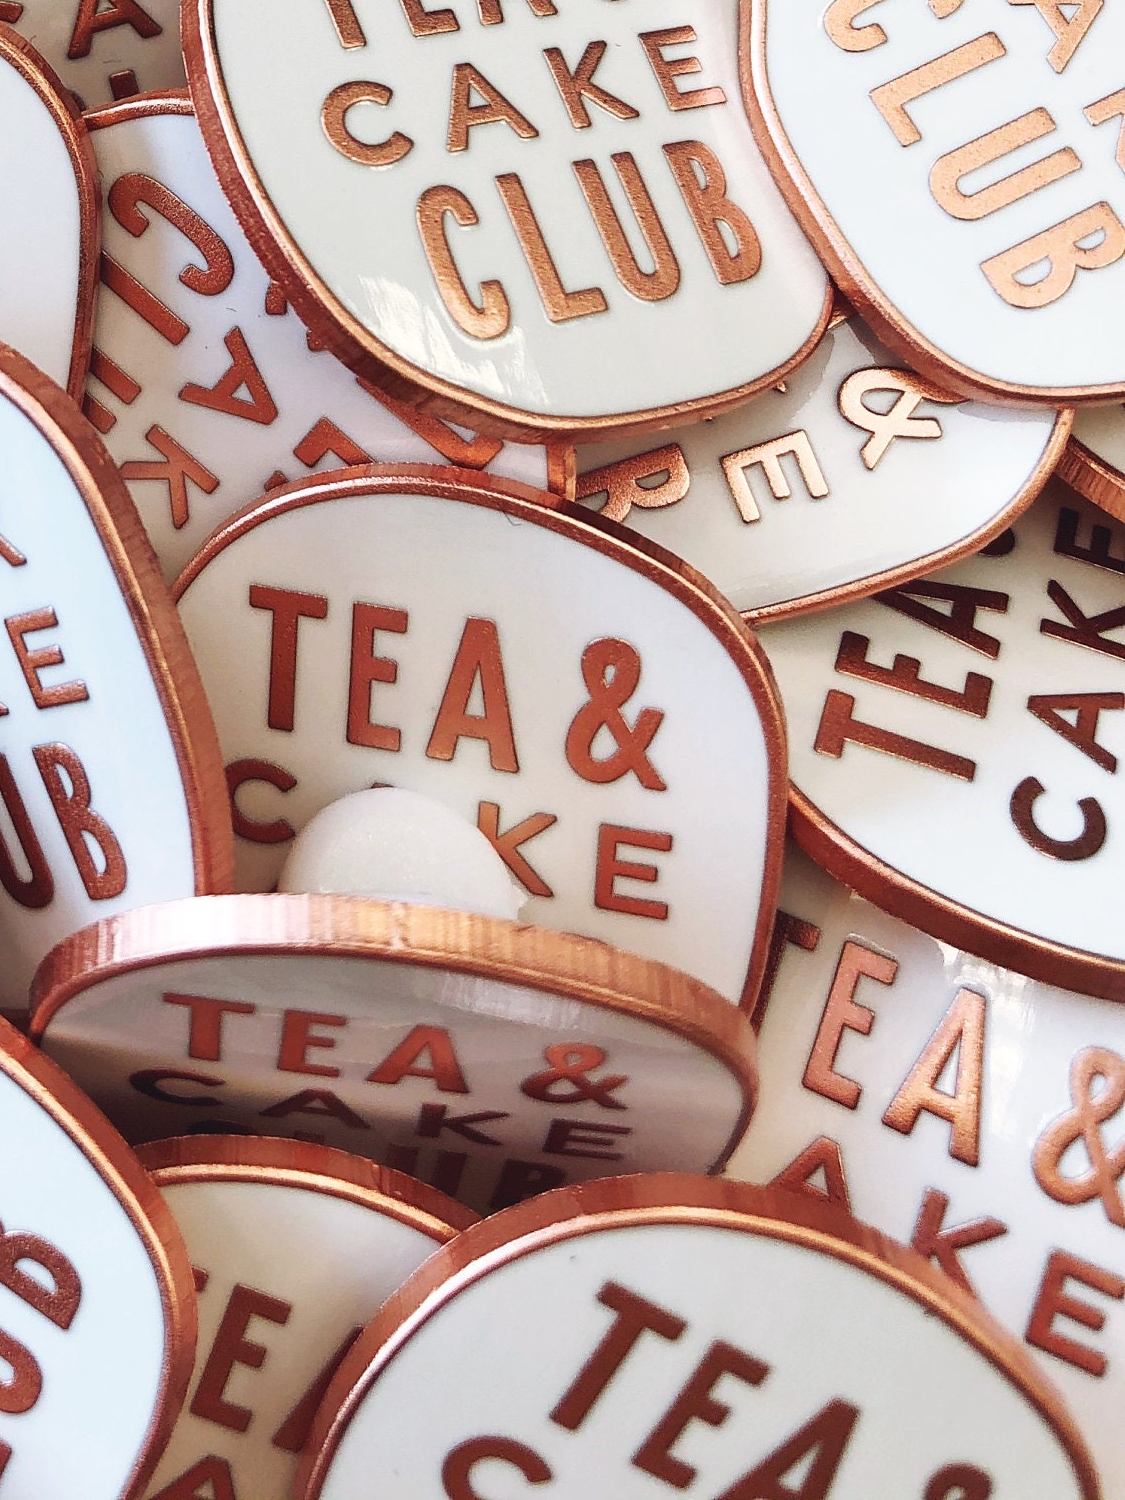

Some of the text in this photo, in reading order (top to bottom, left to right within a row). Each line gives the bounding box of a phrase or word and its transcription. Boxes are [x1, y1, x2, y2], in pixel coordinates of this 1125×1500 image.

[321, 25, 726, 167] CAKE
[416, 140, 761, 340] CLUB
[249, 585, 666, 791] TEA &
[814, 580, 1009, 782] TEA
[226, 759, 672, 920] CKE
[128, 1068, 632, 1160] CAKE
[163, 993, 628, 1109] TEA &
[1033, 1046, 1125, 1228] &
[550, 1278, 860, 1500] TEA
